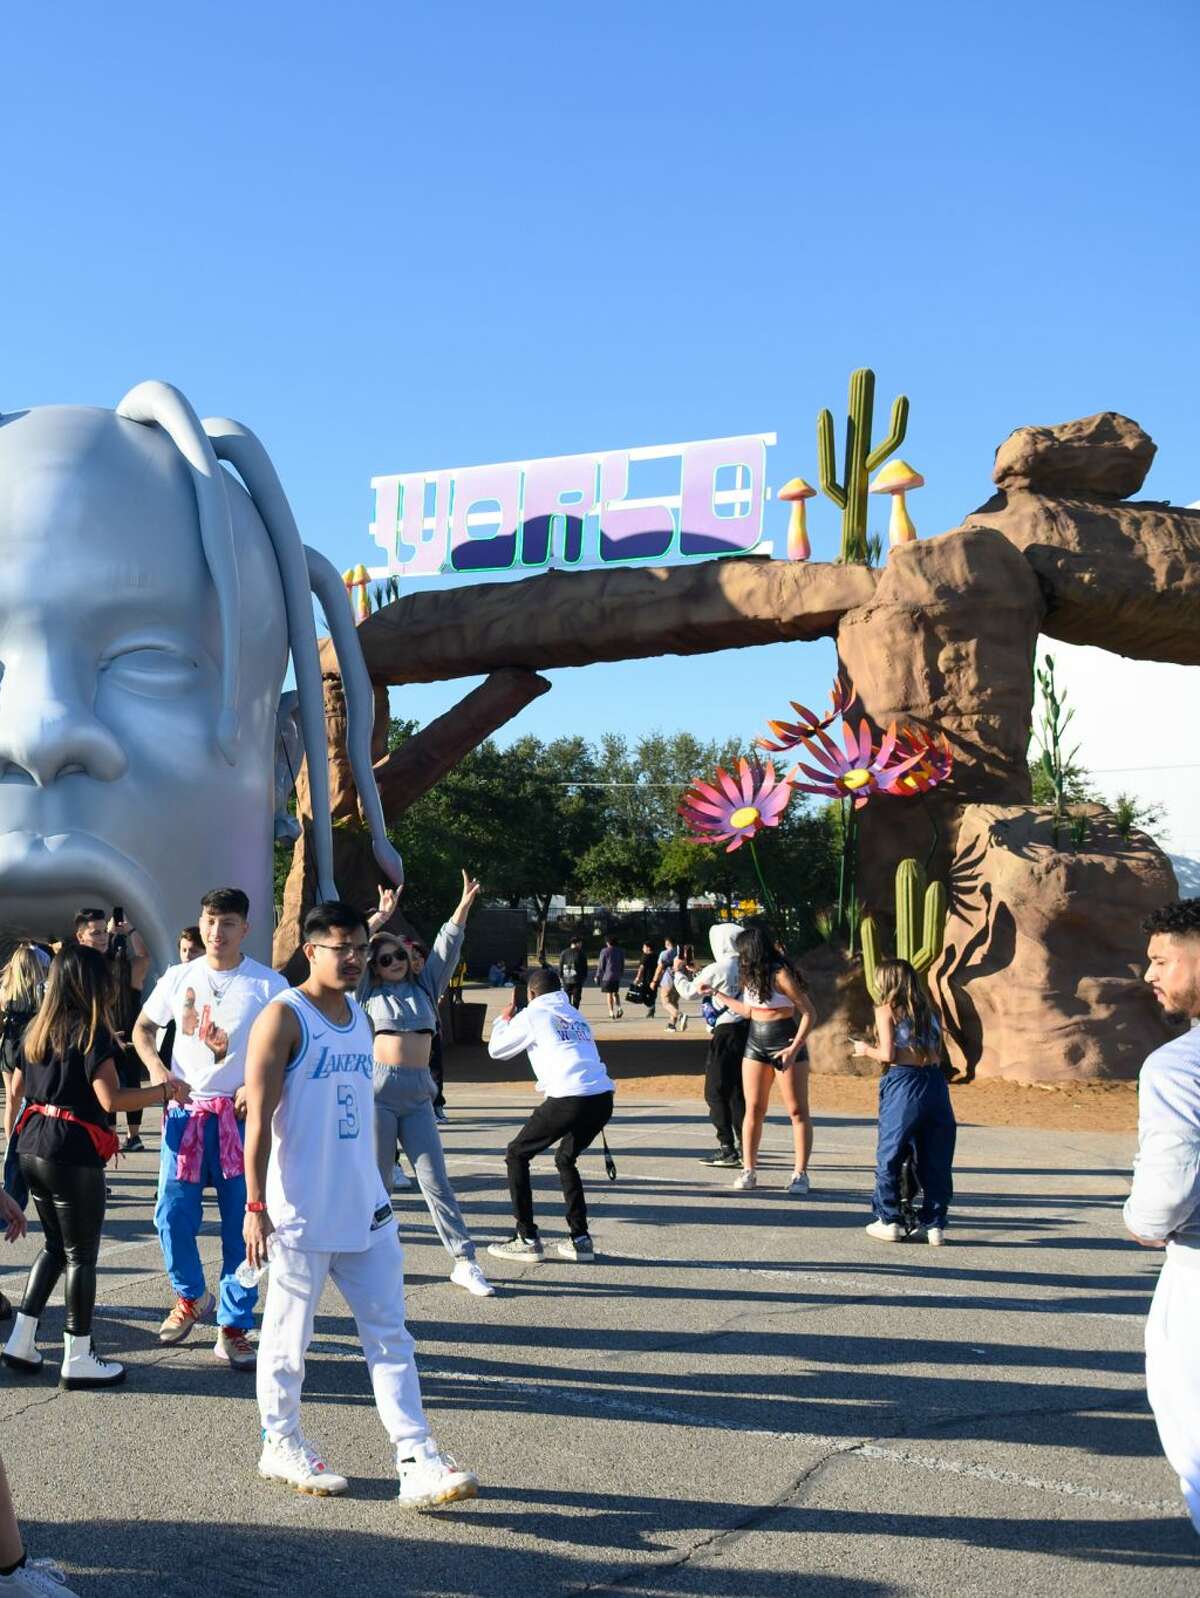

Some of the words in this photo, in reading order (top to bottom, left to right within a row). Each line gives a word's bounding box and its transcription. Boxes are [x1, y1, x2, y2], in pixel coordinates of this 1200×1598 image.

[373, 437, 767, 575] WORLD
[308, 1046, 374, 1080] LAKERS
[337, 1085, 360, 1139] 3
